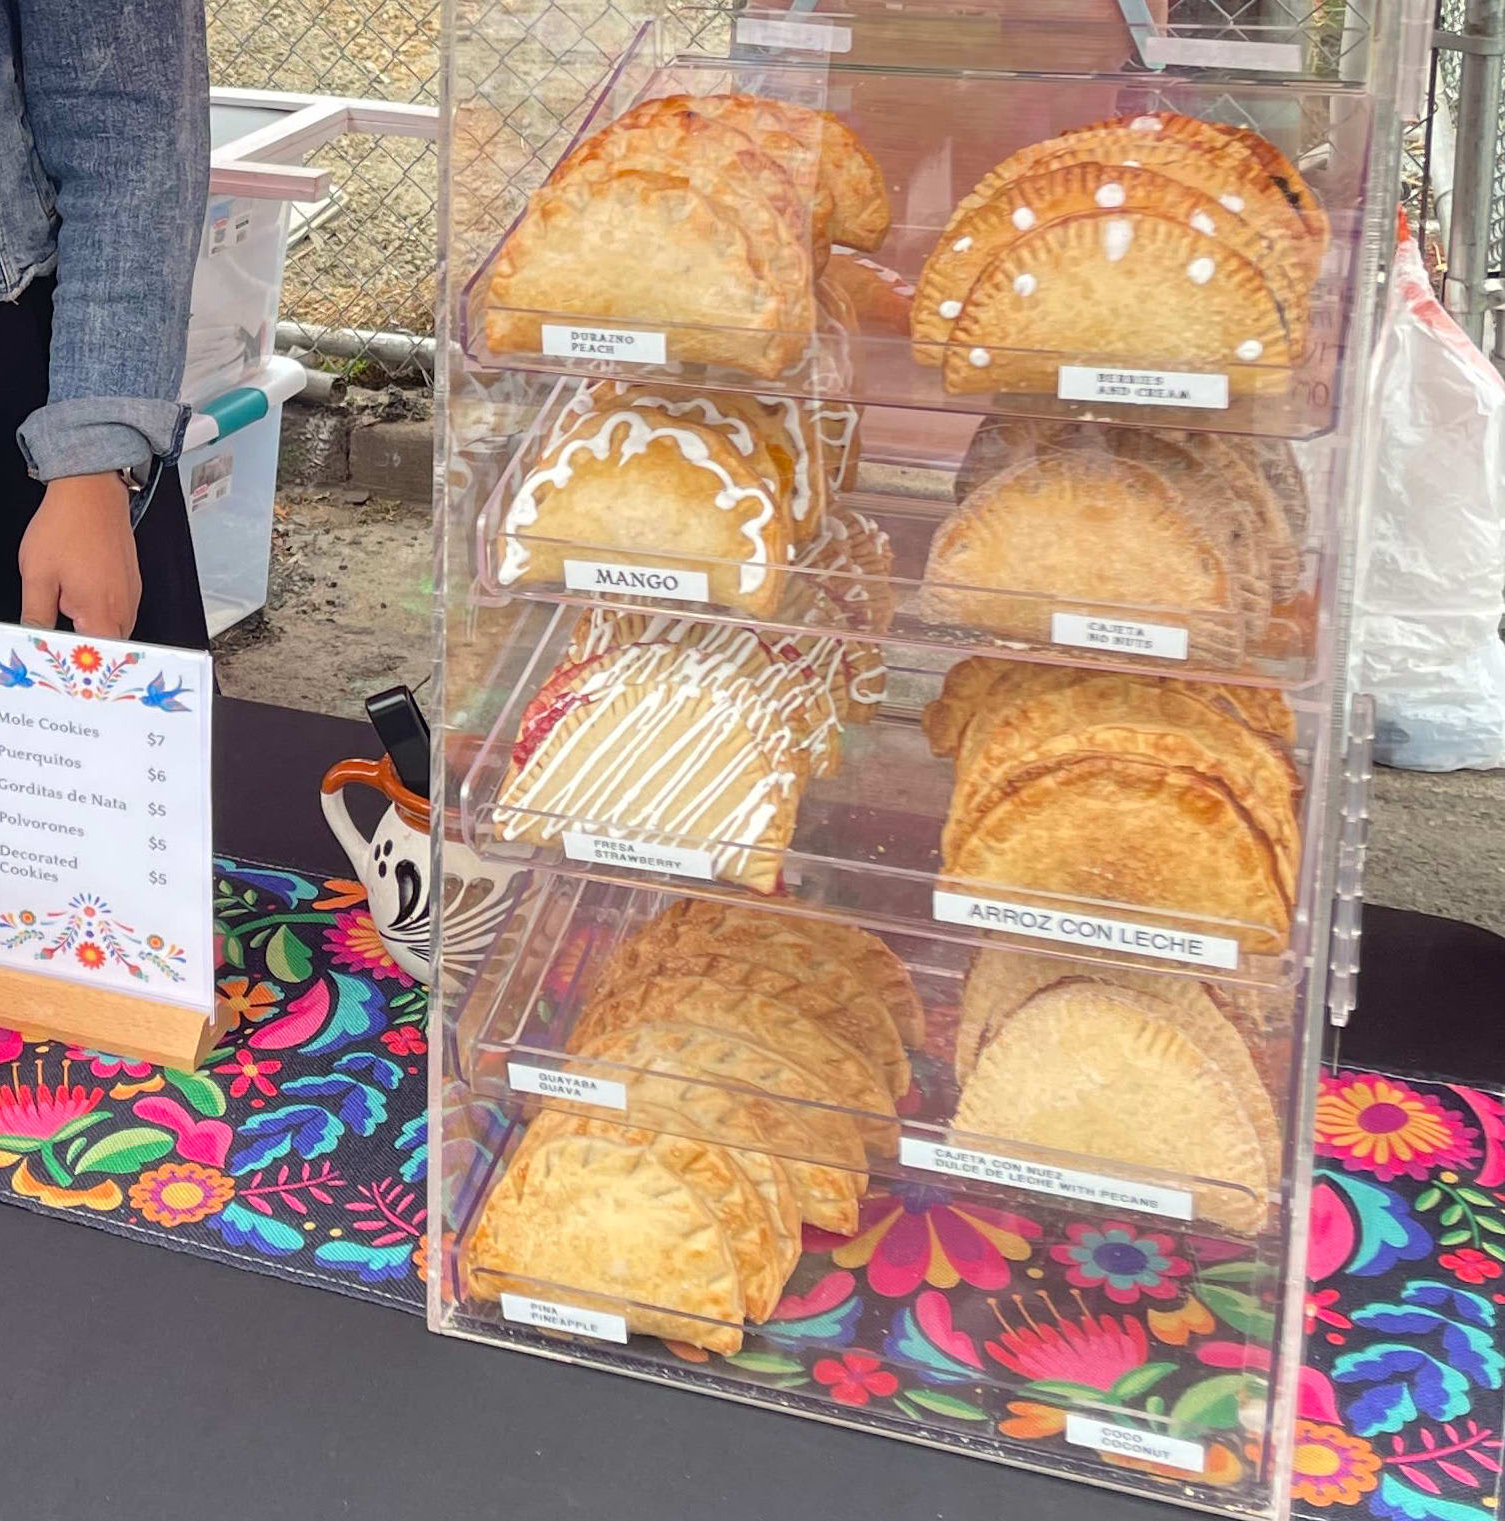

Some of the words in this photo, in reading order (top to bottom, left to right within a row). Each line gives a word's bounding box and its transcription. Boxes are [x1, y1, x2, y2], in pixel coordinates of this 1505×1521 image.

[571, 331, 635, 345] DURAZNO
[571, 342, 615, 354] PEACH
[1096, 373, 1165, 386] BERRIES
[1096, 386, 1131, 396] AND
[1135, 387, 1192, 400] CREAM
[596, 568, 679, 591] MANGO
[1087, 622, 1145, 637] CAJETA
[1087, 633, 1110, 643] NO
[1112, 636, 1154, 649] NUTS
[38, 717, 100, 738] Cookies
[147, 732, 166, 747] $7
[147, 767, 167, 783] $6
[67, 789, 87, 804] de
[91, 793, 127, 811] Nata
[148, 802, 167, 817] $5
[148, 836, 167, 851] $5
[594, 840, 635, 853] FRESA
[0, 844, 79, 870] Decorated
[148, 870, 168, 885] $5
[594, 849, 682, 869] STRAWBERRY
[0, 861, 59, 883] Cookies
[968, 903, 1053, 931] ARROZ
[1058, 918, 1113, 942] CON
[1118, 927, 1204, 956] LECHE
[538, 1072, 598, 1090] GUAYABA
[538, 1082, 582, 1097] GUAVA
[934, 1148, 987, 1166] CAJETA
[991, 1158, 1023, 1173] CON
[1025, 1165, 1065, 1181] NUEZ
[934, 1158, 981, 1176] DULCE
[985, 1166, 1005, 1179] DE
[1008, 1170, 1057, 1189] LECHE
[1058, 1182, 1096, 1198] WITH
[1100, 1189, 1161, 1210] PECANS
[531, 1312, 600, 1333] PINEAPPLE
[1101, 1427, 1144, 1443] COCO
[1101, 1437, 1172, 1459] COCONUT
